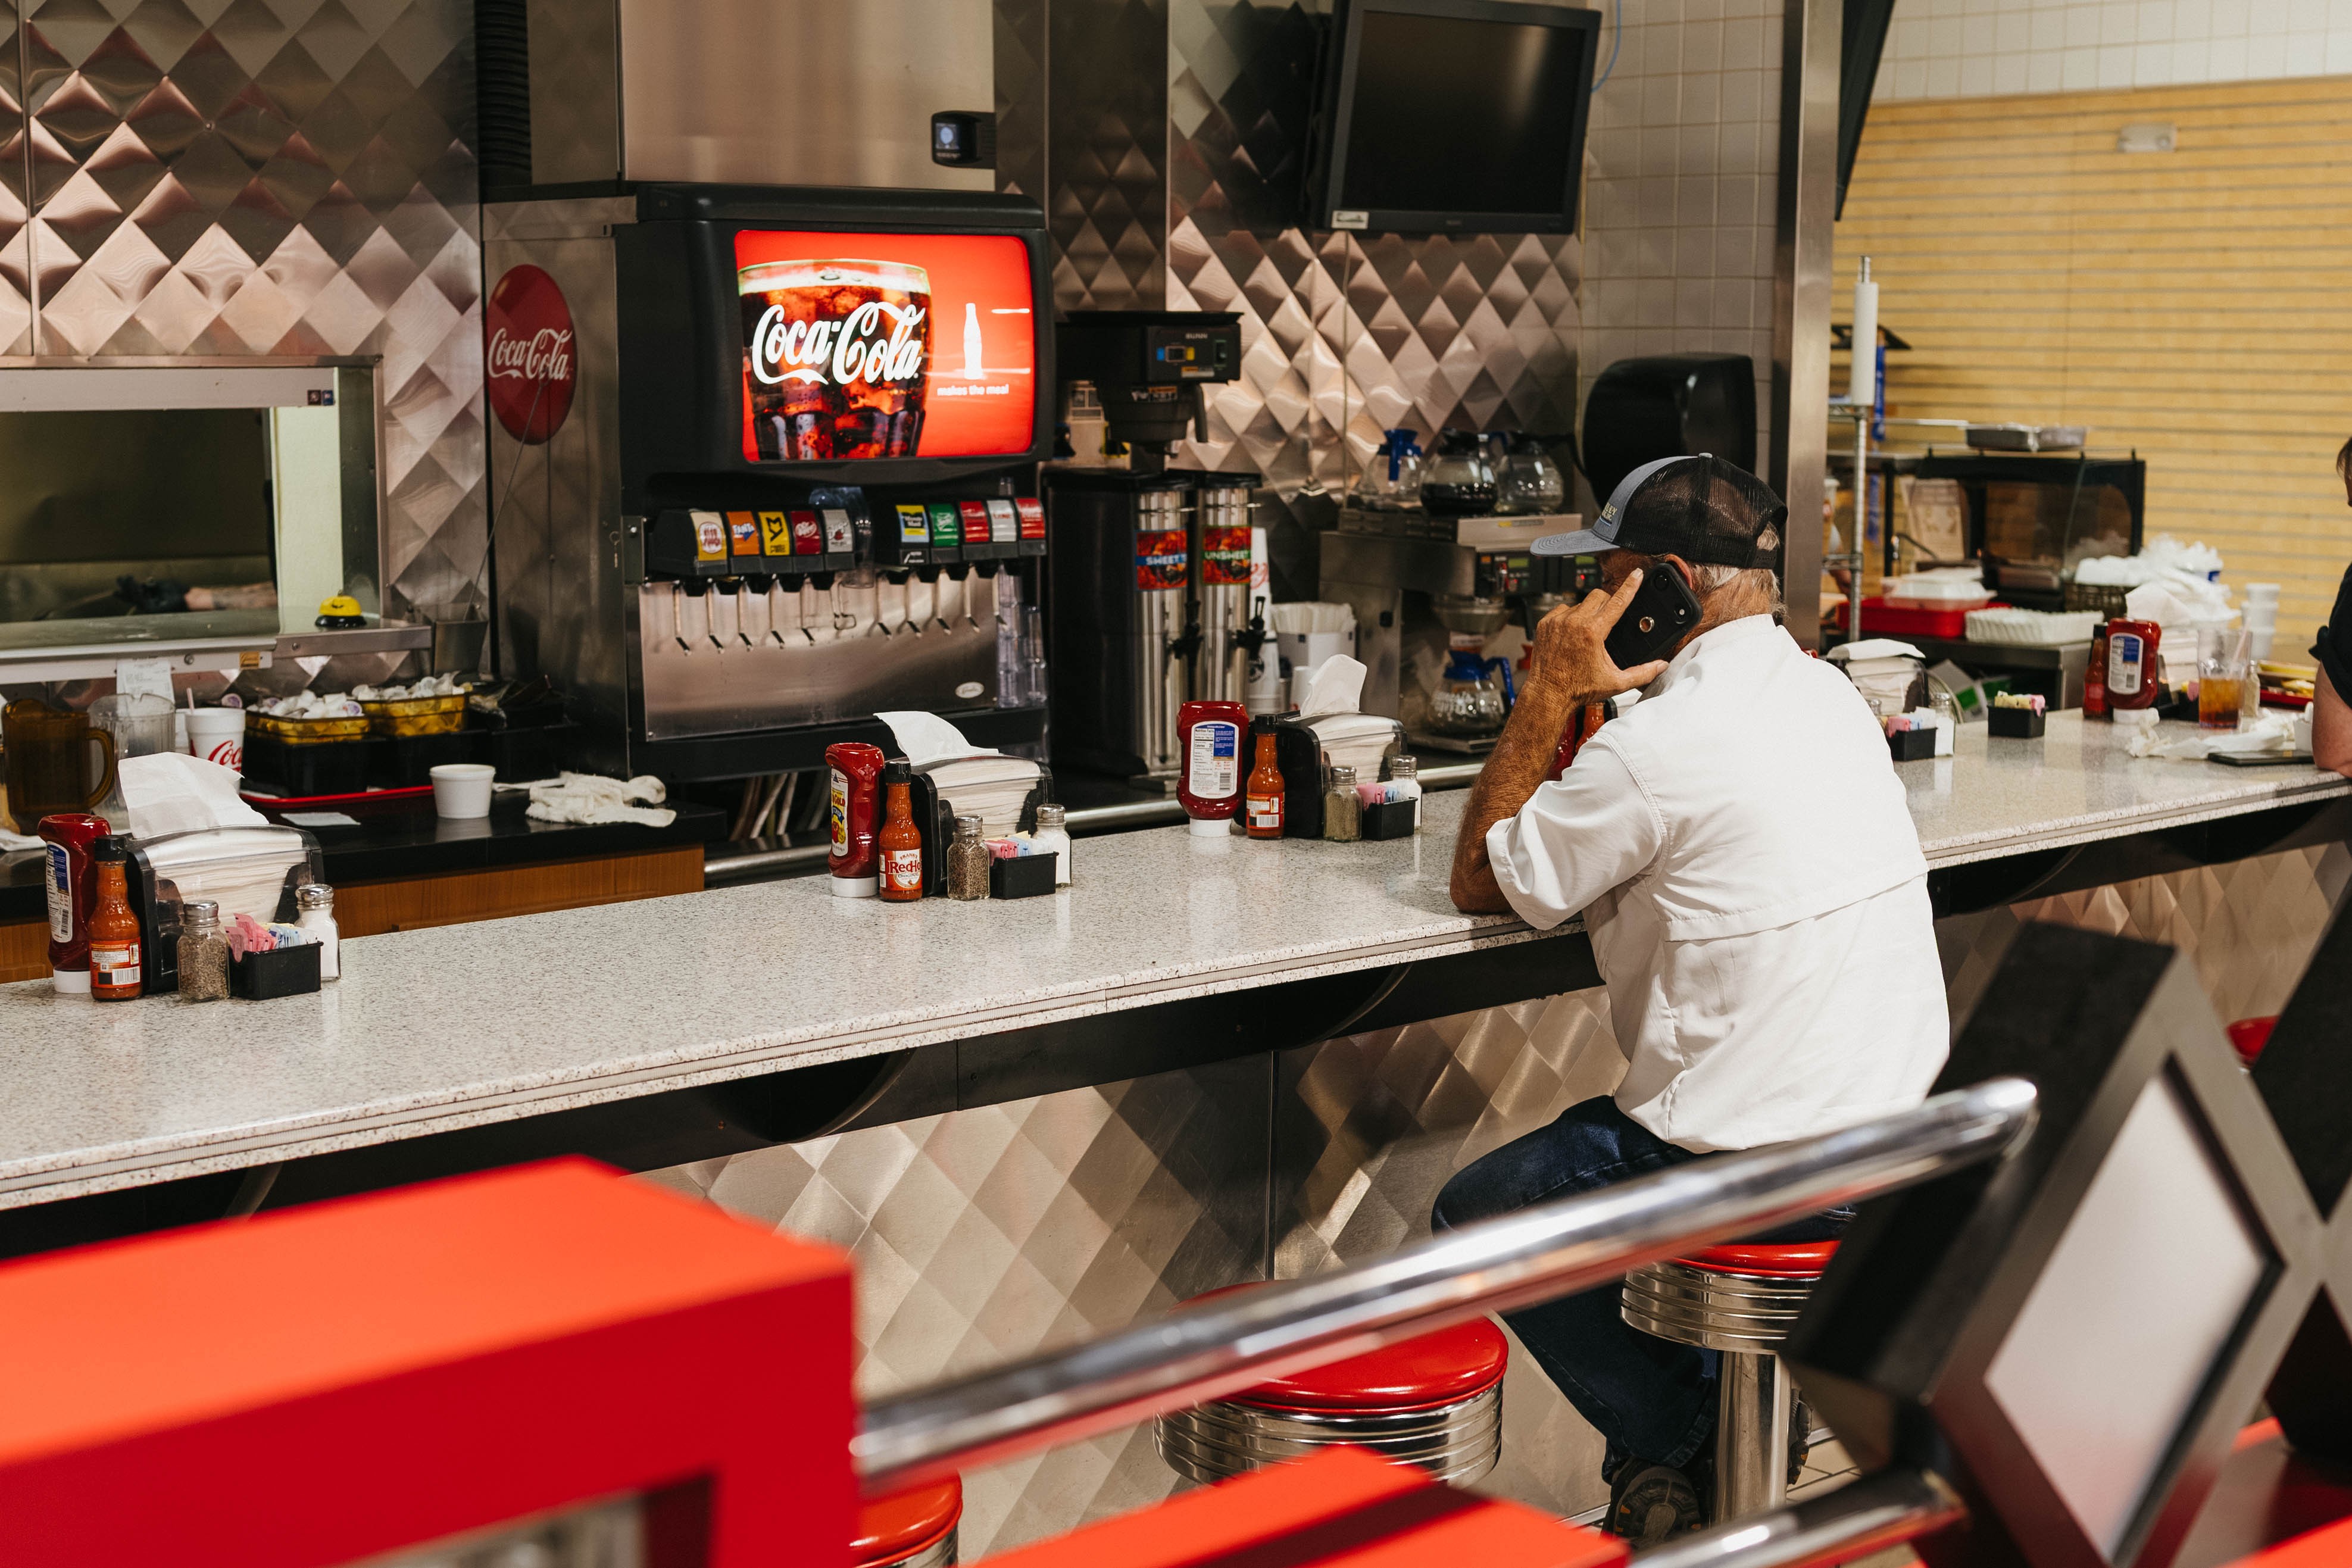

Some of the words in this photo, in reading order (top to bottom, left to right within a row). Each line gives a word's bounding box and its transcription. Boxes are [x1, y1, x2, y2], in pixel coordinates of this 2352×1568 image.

[752, 301, 926, 386] Coca-Cola
[487, 327, 573, 380] Coca-Cola
[936, 385, 968, 396] makes
[969, 385, 985, 395] the
[986, 383, 1010, 395] meal
[1145, 555, 1179, 566] SWEET
[888, 859, 922, 875] RedHo
